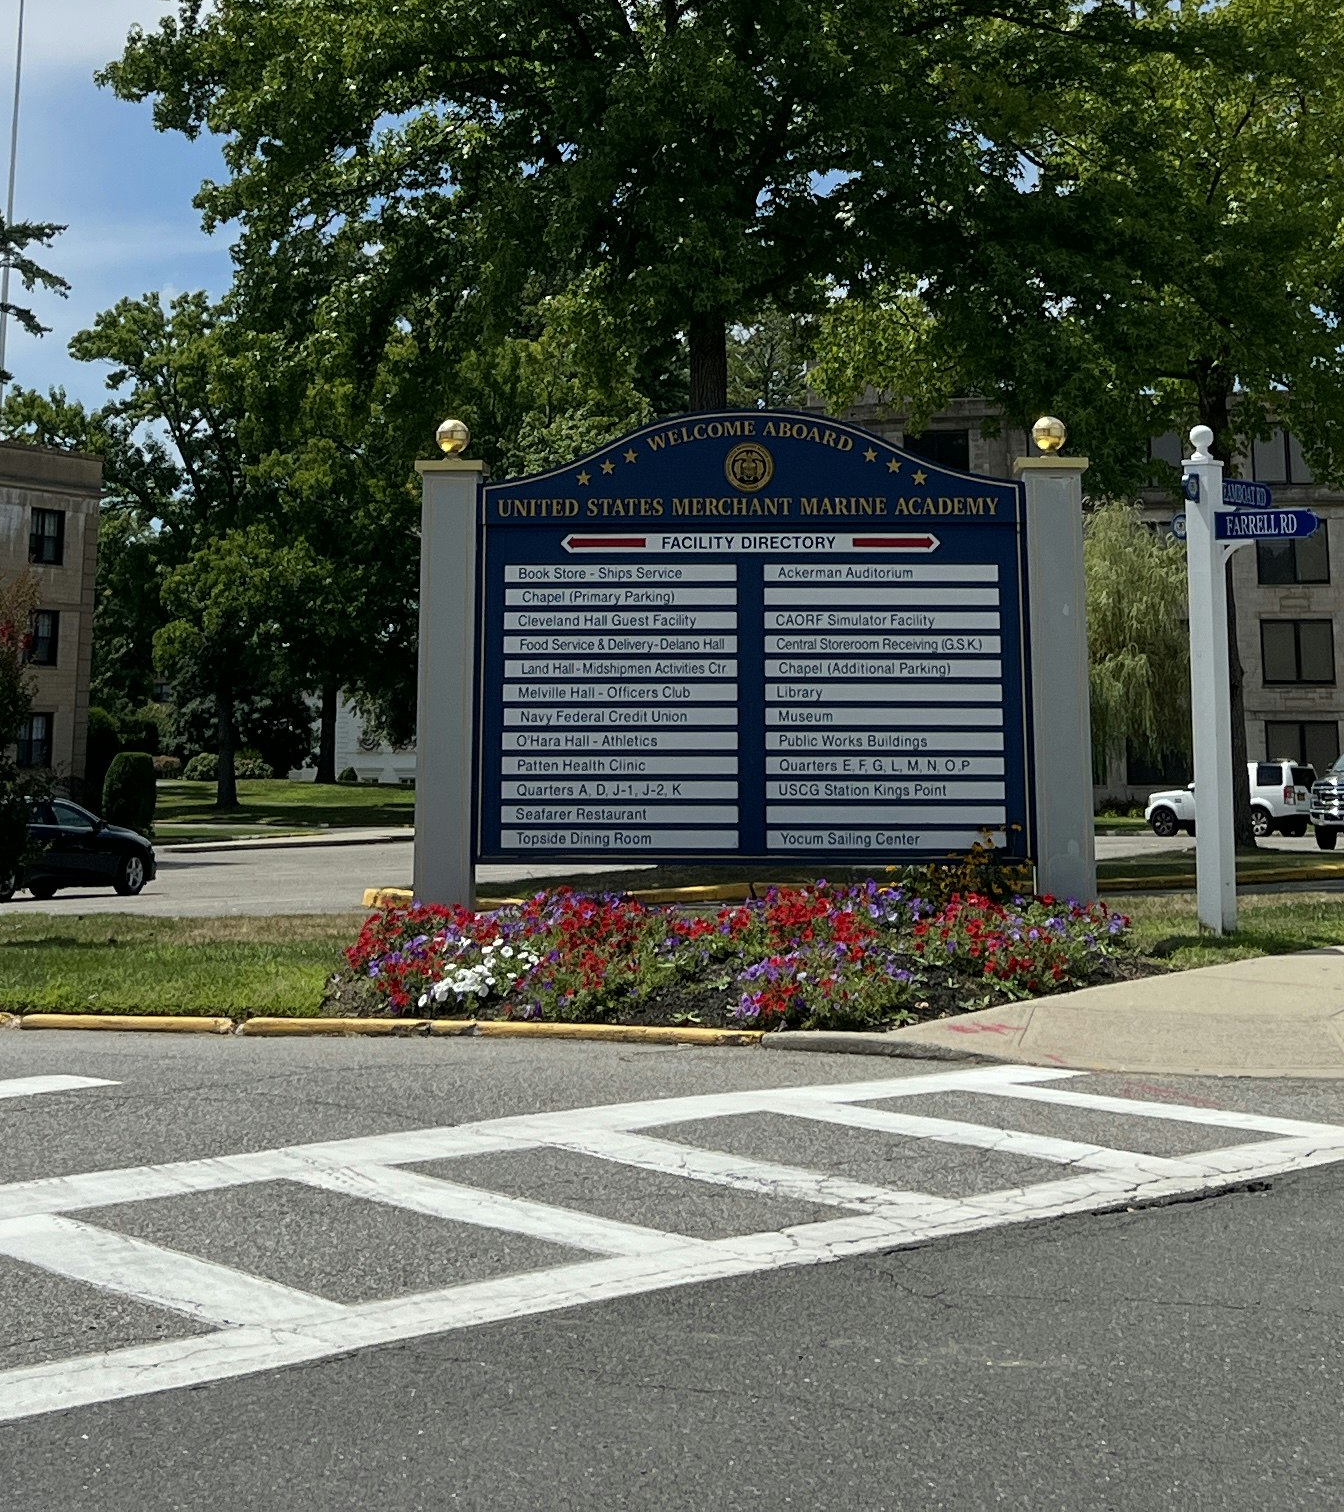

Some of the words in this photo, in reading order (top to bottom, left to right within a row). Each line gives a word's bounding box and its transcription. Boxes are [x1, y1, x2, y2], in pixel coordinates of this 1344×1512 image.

[646, 420, 755, 452] WELCOME
[763, 421, 854, 452] ABOARD
[498, 499, 579, 518] UNITED
[587, 498, 663, 517] STATES
[672, 498, 793, 517] MERCHANT
[800, 497, 887, 516] MARINE
[895, 497, 999, 516] ACADEMY
[1226, 514, 1278, 535] FARRELL
[1280, 514, 1297, 534] RD
[662, 536, 735, 550] FACILITY
[741, 535, 836, 550] DIRECTORY
[518, 568, 550, 579] Book
[554, 568, 586, 579] Store
[598, 567, 632, 581] Ships
[636, 567, 682, 579] Service
[778, 567, 842, 579] Ackerman
[846, 567, 913, 579] Auditorium
[522, 591, 565, 605] Chapel
[569, 591, 621, 605] (Primary
[625, 591, 675, 605] Parking)
[518, 615, 579, 626] Cleveland
[584, 615, 607, 626] Hall
[612, 614, 649, 626] Guest
[653, 614, 697, 628] Facility
[776, 614, 824, 626] CAORF
[828, 614, 886, 626] Simulator
[891, 614, 935, 629] Facility
[520, 639, 548, 650] Food
[552, 639, 594, 650] Service
[598, 639, 605, 650] &
[703, 638, 725, 650] Hall
[777, 638, 817, 650] Central
[820, 638, 879, 650] Storeroom
[883, 638, 938, 653] Receiving
[522, 663, 549, 674] Land
[655, 662, 705, 674] Activities
[779, 662, 822, 676] Chapel
[827, 662, 895, 675] (Additional
[900, 662, 951, 677] Parking)
[518, 687, 566, 698] Melville
[571, 687, 595, 698] Hall
[607, 686, 658, 698] Officers
[662, 686, 690, 698] Club
[777, 686, 823, 701] Library
[521, 711, 552, 726] Navy
[557, 711, 605, 722] Federal
[609, 711, 648, 722] Credit
[651, 711, 687, 722] Union
[779, 710, 833, 722] Museum
[517, 735, 560, 747] O'Hara
[565, 735, 589, 747] Hall
[602, 735, 658, 747] Athletics
[779, 735, 818, 747] Public
[822, 735, 863, 747] Works
[868, 735, 928, 749] Buildings
[517, 759, 558, 771] Patten
[563, 759, 605, 771] Health
[609, 759, 646, 771] Clinic
[779, 759, 837, 772] Quarters
[517, 784, 574, 796] Quarters
[673, 784, 682, 795] K
[779, 784, 820, 796] USCG
[824, 784, 869, 796] Station
[874, 784, 910, 799] Kings
[915, 784, 947, 796] Point
[516, 808, 572, 820] Seafarer
[576, 808, 646, 820] Restaurant
[517, 832, 566, 847] Topside
[571, 832, 609, 847] Dining
[614, 832, 652, 845] Room
[781, 832, 824, 845] Yocum
[828, 832, 871, 847] Sailing
[876, 832, 920, 845] Center
